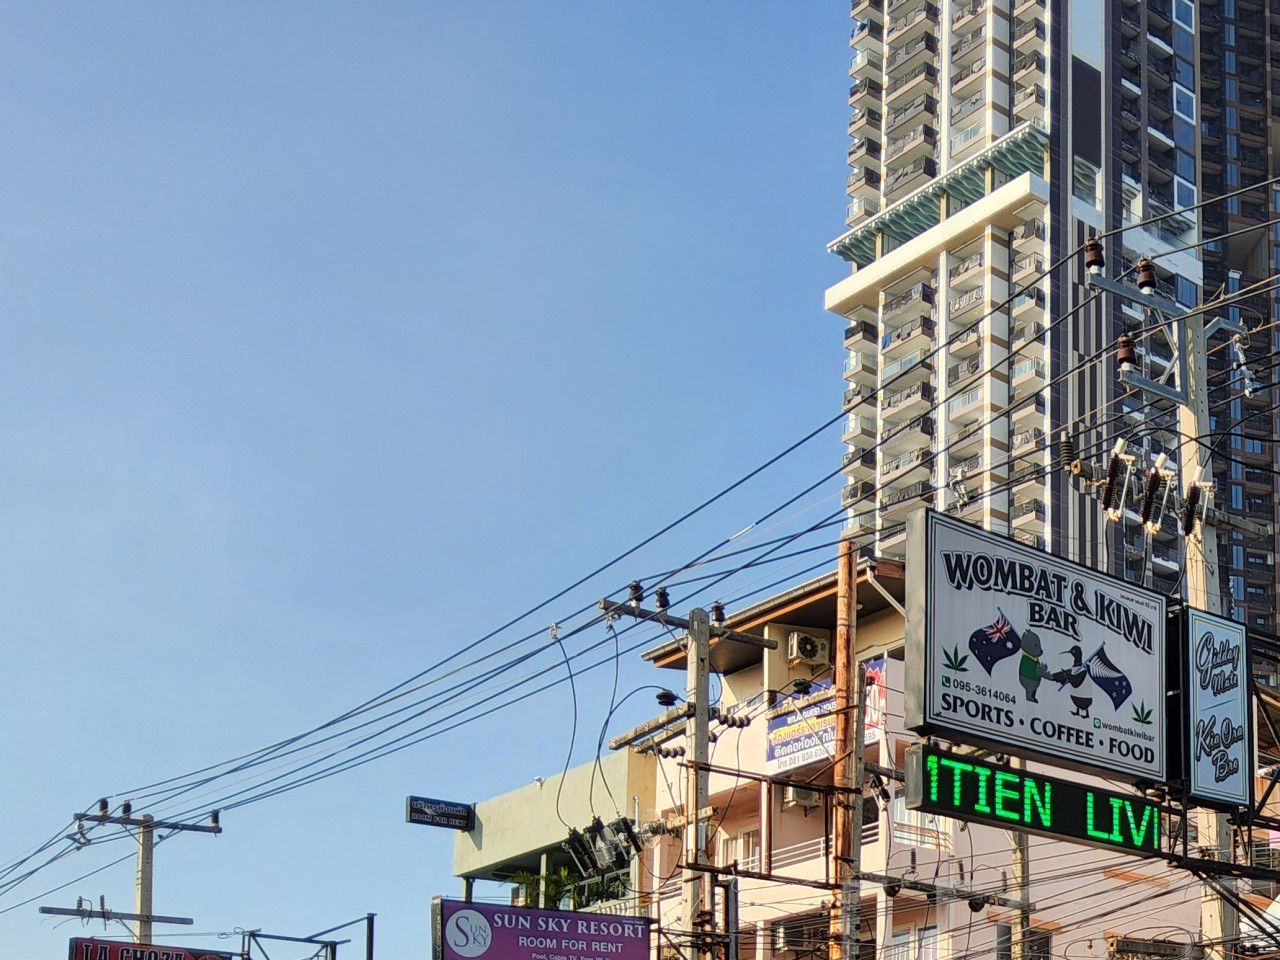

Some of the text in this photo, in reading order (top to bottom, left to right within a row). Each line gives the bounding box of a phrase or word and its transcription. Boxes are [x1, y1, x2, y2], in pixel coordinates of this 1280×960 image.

[943, 552, 1155, 654] WOMBAT & KIWI
[1028, 600, 1082, 640] BAR
[953, 678, 1016, 705] 095-3614064
[1212, 670, 1238, 697] Mate
[941, 693, 1155, 764] SPORTS COFFEE FOOD
[1102, 720, 1155, 742] wombatkiwibar
[1196, 715, 1243, 761] Kia Ora
[1212, 750, 1239, 782] Bro
[1087, 792, 1158, 849] LIV
[493, 913, 646, 938] SUN SKY RESORT
[518, 936, 624, 953] ROOM FOR RENT
